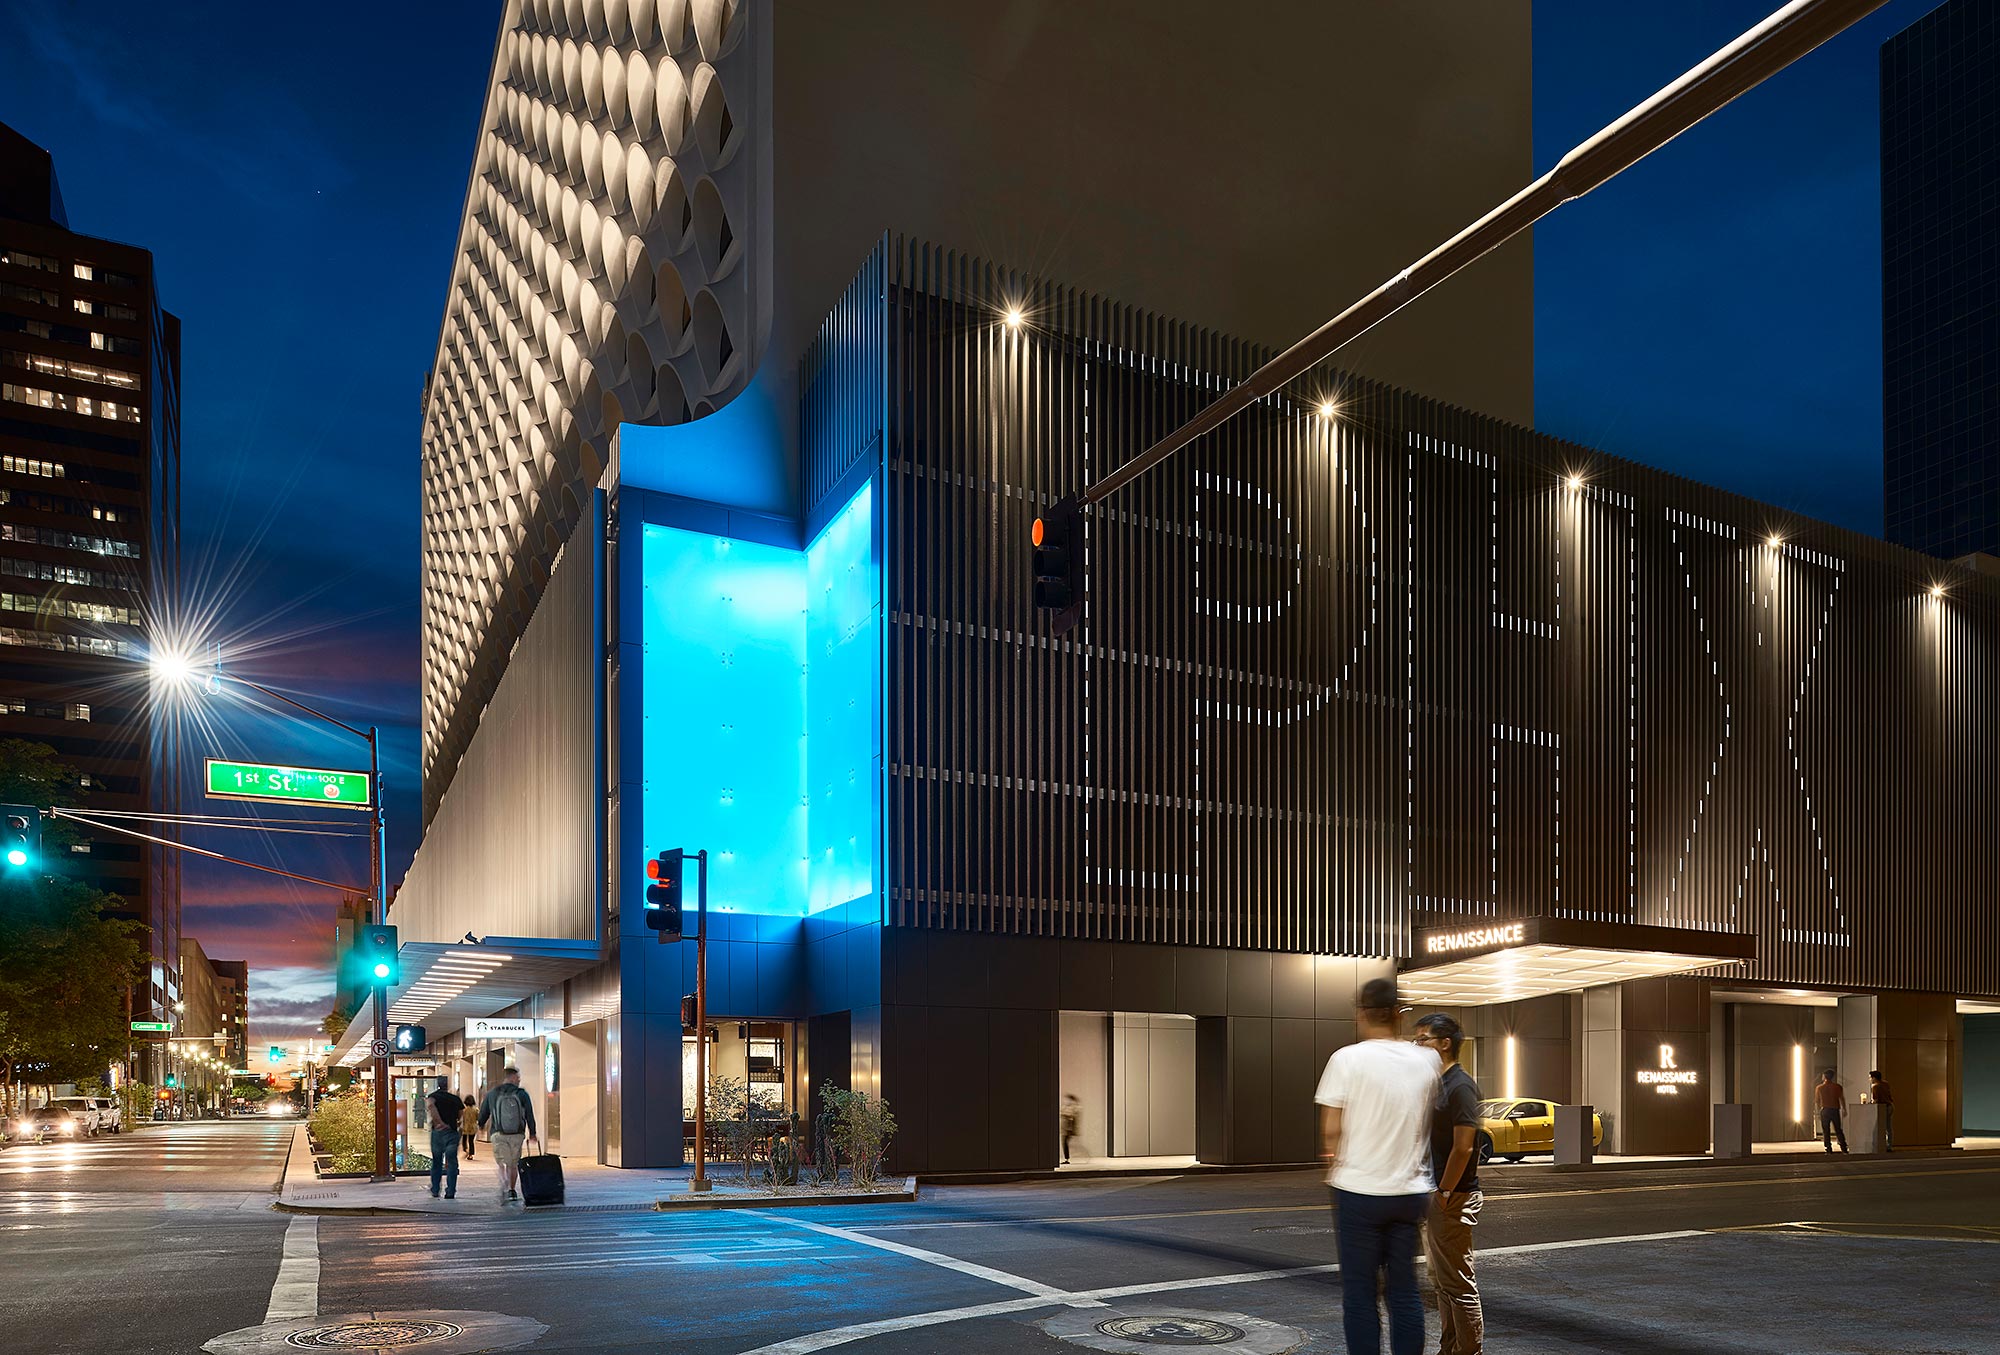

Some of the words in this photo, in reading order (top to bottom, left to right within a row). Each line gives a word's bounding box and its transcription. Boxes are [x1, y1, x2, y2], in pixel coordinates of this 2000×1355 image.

[233, 771, 260, 788] 1st
[267, 774, 299, 792] St.
[317, 774, 337, 784] 100
[338, 776, 345, 785] E
[1428, 924, 1523, 952] RENAISSANCE
[1659, 1044, 1677, 1068] R
[1637, 1071, 1697, 1083] RENAISSANCE
[1656, 1085, 1678, 1094] HOTEL
